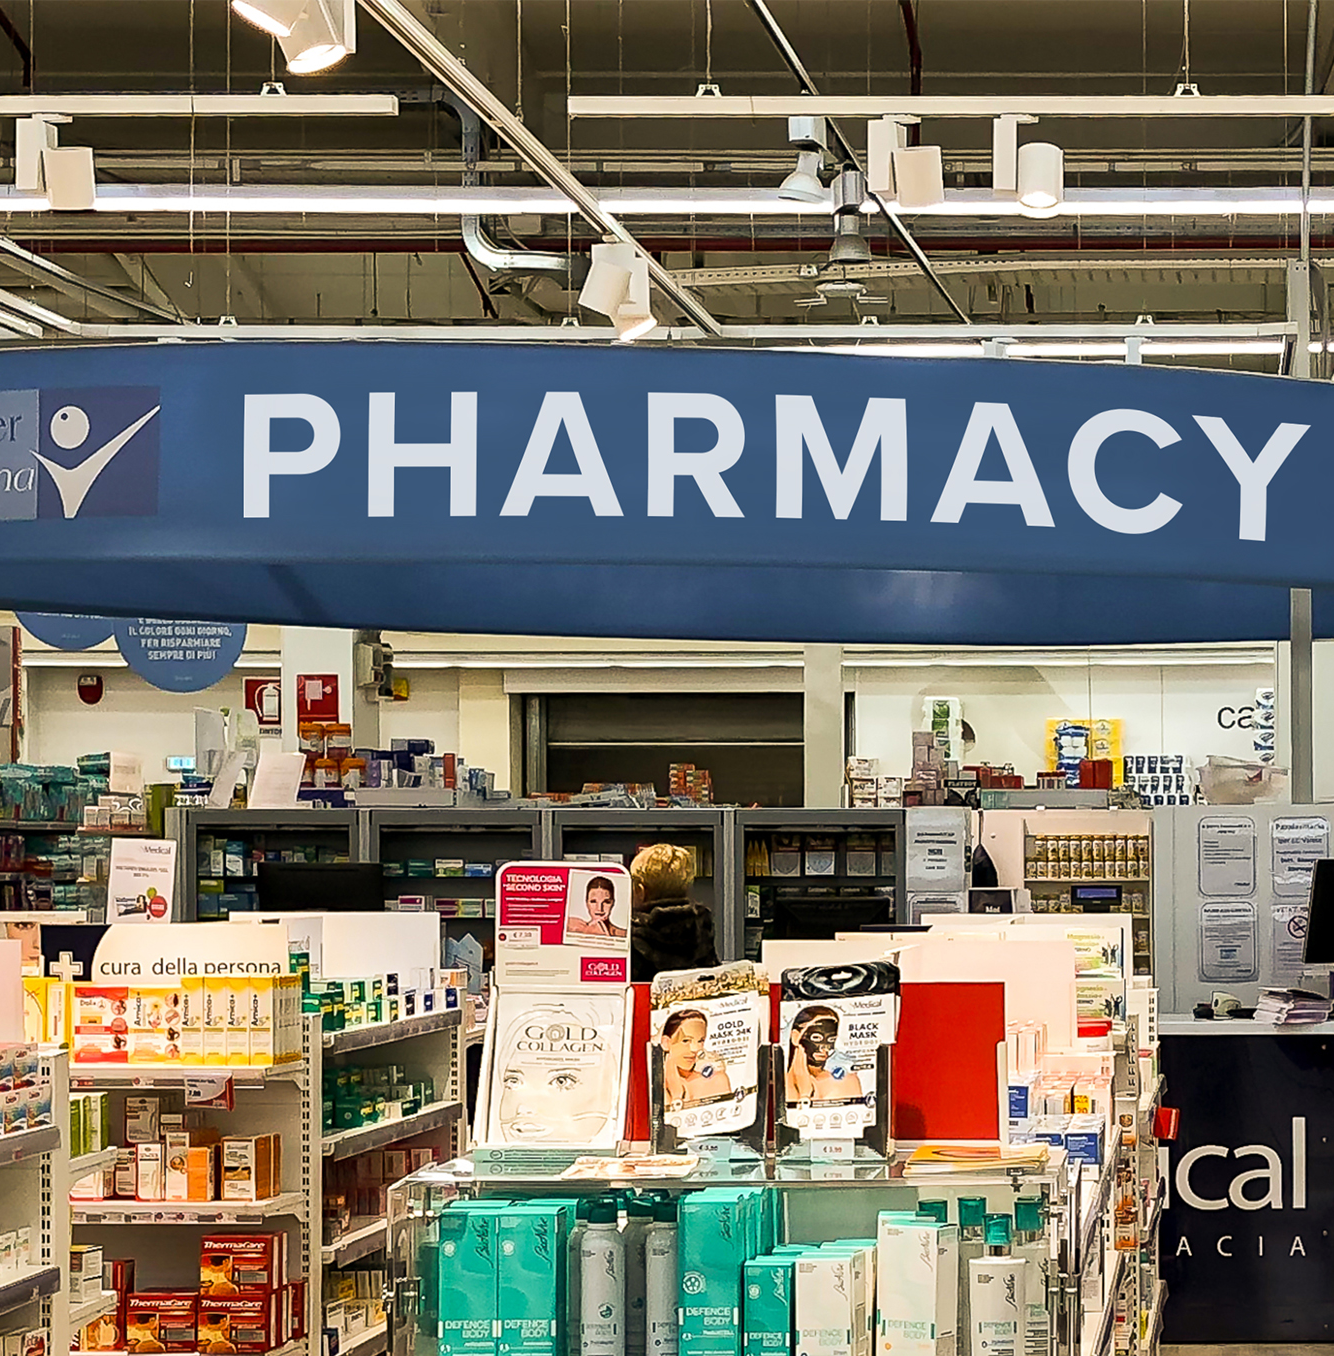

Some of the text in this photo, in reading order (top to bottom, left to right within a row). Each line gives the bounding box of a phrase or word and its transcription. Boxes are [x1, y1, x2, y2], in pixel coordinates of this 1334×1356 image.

[243, 391, 1311, 543] PHARMACY
[506, 874, 563, 885] TECNOLOGIA
[99, 957, 282, 976] cura della persona
[717, 1019, 745, 1031] GOLD
[848, 1022, 879, 1031] BLACK
[524, 1023, 598, 1042] GOLD
[709, 1029, 734, 1040] MASK
[849, 1031, 878, 1040] MASK
[204, 1240, 266, 1251] ThermaCare
[129, 1298, 193, 1308] ThermaCare
[200, 1299, 264, 1309] ThermaCare
[685, 1307, 731, 1316] DEFENCE
[444, 1320, 491, 1329] DEFENCE
[503, 1319, 550, 1329] DEFENCE
[703, 1316, 731, 1326] BODY
[887, 1320, 928, 1331] DEFENCE
[462, 1329, 490, 1338] BODY
[520, 1329, 549, 1338] BODY
[802, 1329, 844, 1338] DEFENCE
